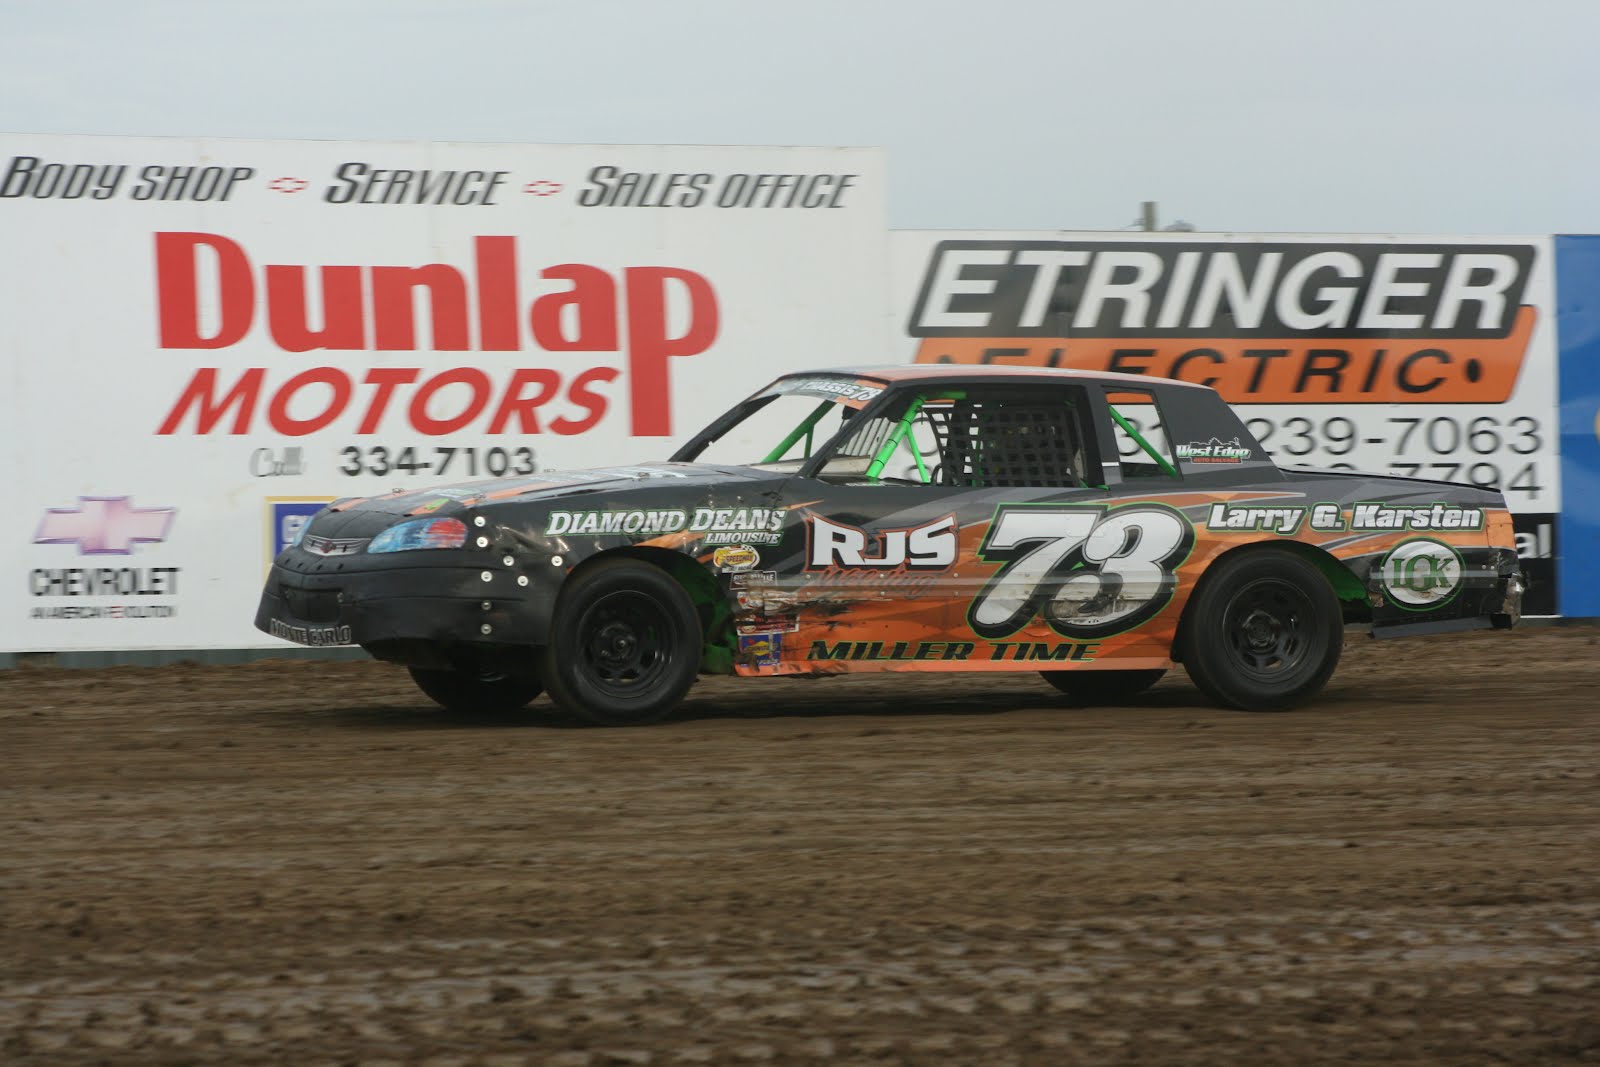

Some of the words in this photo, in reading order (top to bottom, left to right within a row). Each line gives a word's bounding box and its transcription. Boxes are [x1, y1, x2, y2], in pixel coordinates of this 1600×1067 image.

[131, 165, 255, 202] SHOP
[324, 162, 511, 206] SERVICE
[576, 165, 713, 208] SALES
[712, 173, 860, 209] OFFICE
[917, 249, 1521, 331] ETRINGER
[153, 232, 722, 437] Dunlap
[153, 366, 625, 437] MOTORS
[338, 445, 537, 478] 334-7103
[1176, 444, 1213, 458] West
[1213, 445, 1250, 460] Edge
[546, 509, 685, 536] DIAMOND
[690, 507, 786, 534] DEANS
[1207, 502, 1306, 535] Larry
[1310, 502, 1347, 532] G.
[1350, 502, 1485, 532] Karsten
[704, 531, 781, 545] LIMOUSINE
[807, 513, 958, 570] RJS
[30, 568, 181, 597] CHEVROLET
[972, 505, 1190, 636] 73
[270, 618, 307, 644] MONTE
[308, 625, 351, 647] CARLO
[806, 640, 976, 661] MILLER
[988, 642, 1101, 662] TIME
